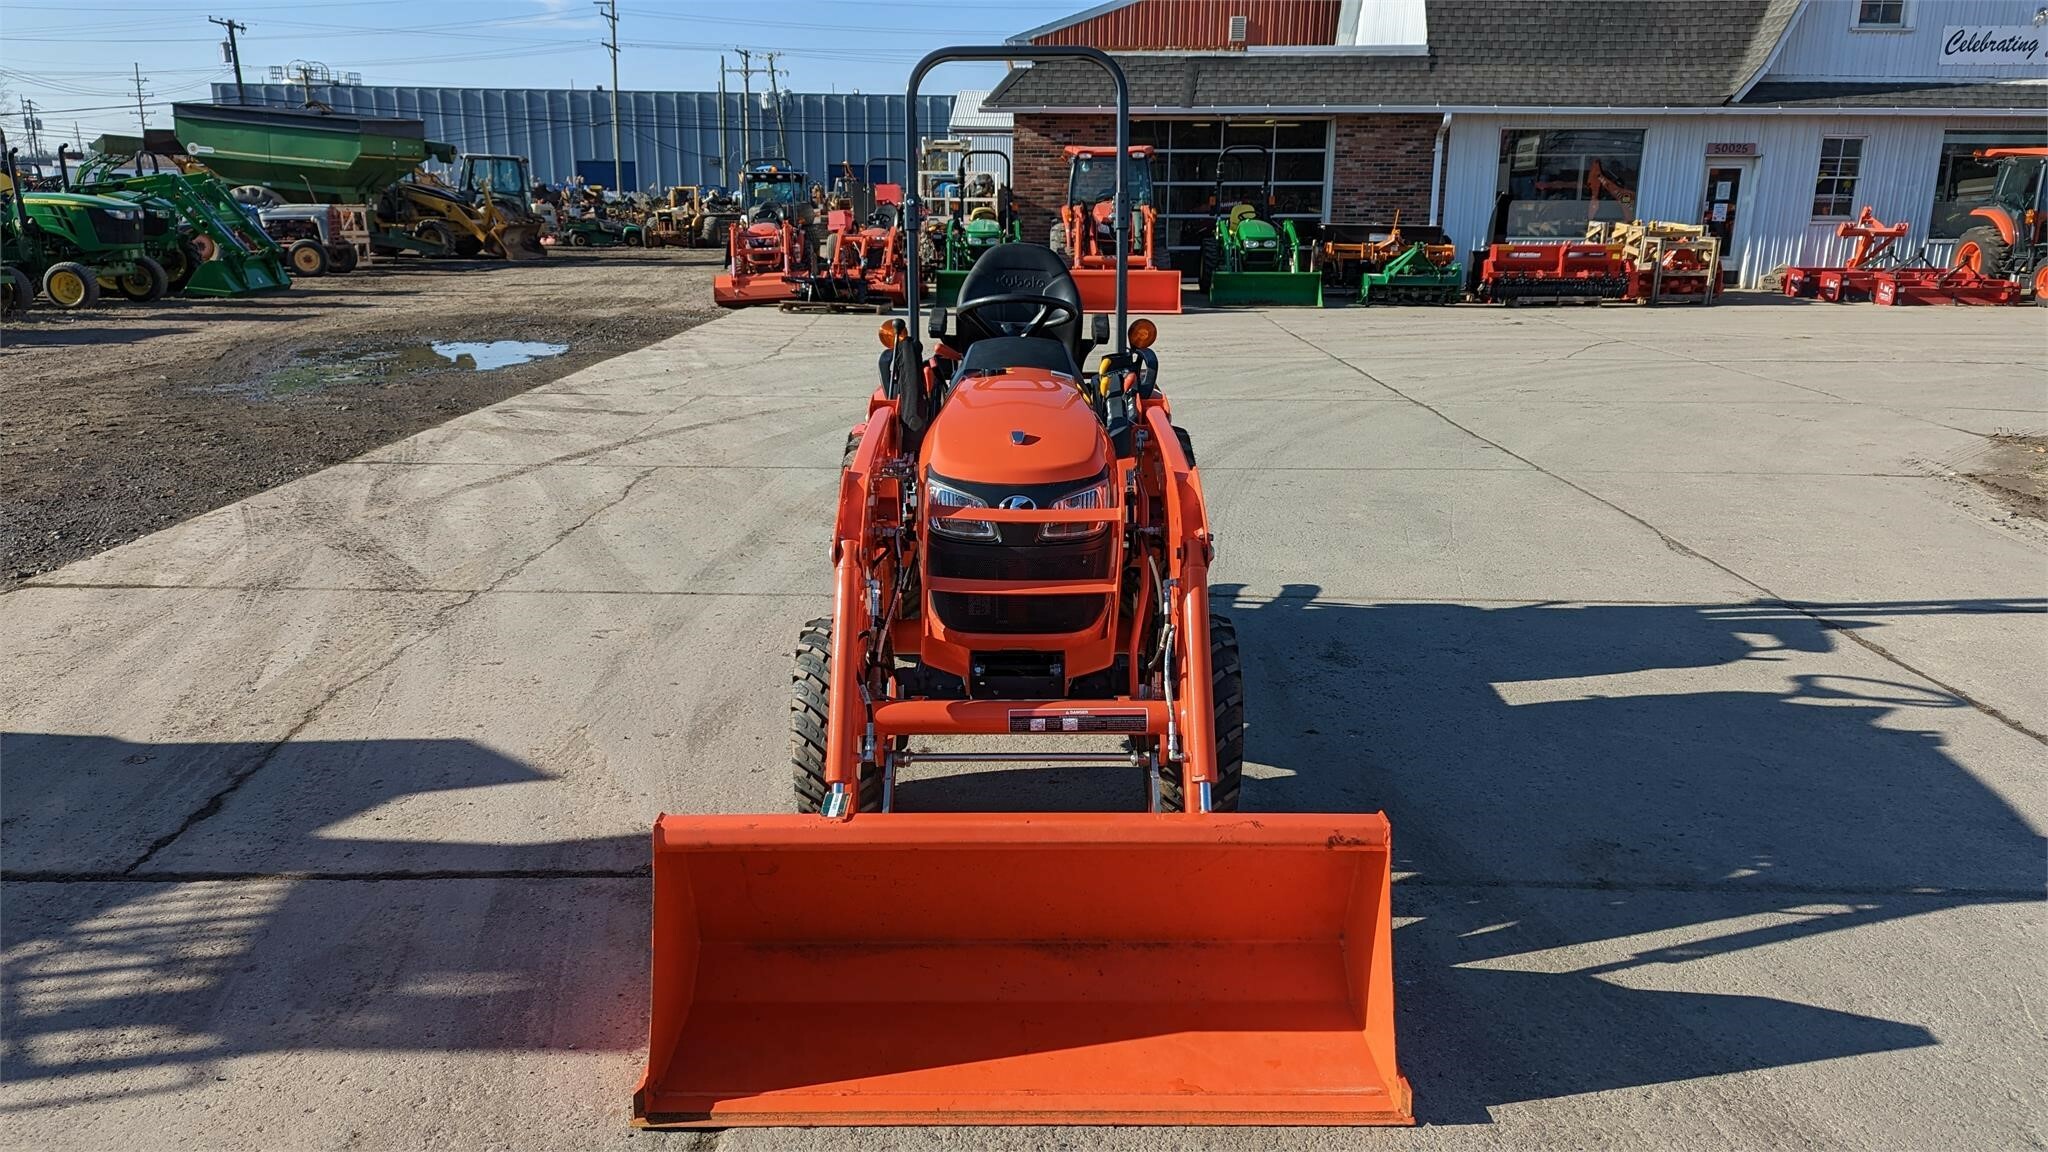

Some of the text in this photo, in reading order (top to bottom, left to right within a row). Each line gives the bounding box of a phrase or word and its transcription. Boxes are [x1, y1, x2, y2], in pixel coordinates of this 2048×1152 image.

[1944, 29, 2040, 60] Celebrating
[1714, 143, 1749, 154] 50025
[996, 274, 1046, 288] Kubota
